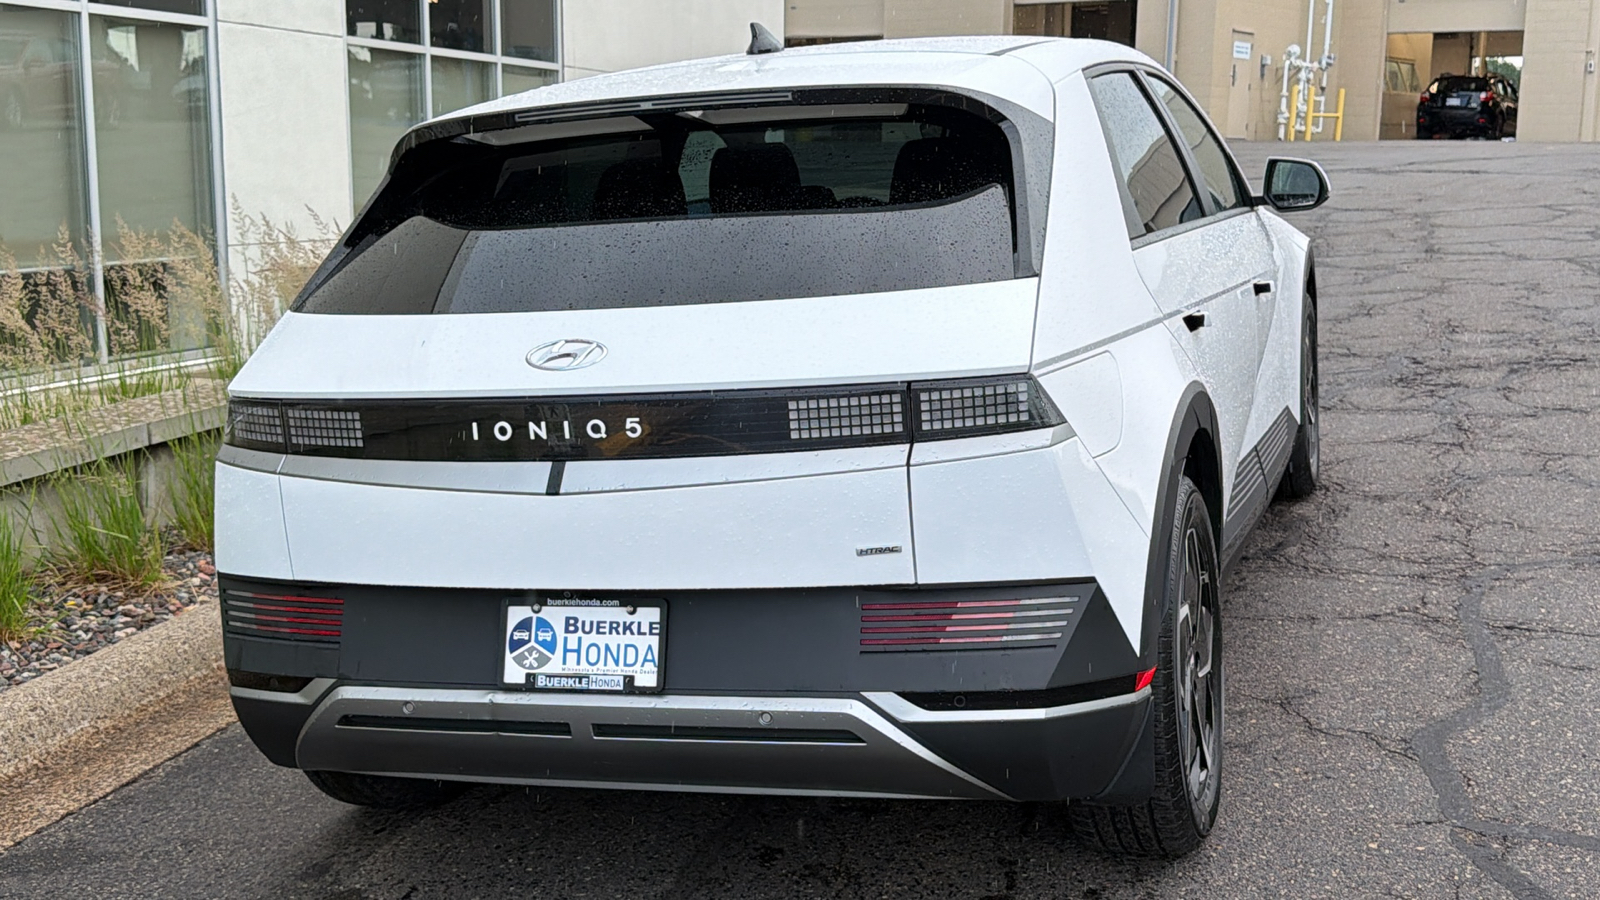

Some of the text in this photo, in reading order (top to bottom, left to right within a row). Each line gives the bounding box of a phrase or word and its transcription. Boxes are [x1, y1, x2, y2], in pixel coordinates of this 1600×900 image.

[471, 417, 643, 442] IONIQ 5
[859, 546, 899, 555] HTRAC
[547, 598, 620, 607] buerklehonda.com
[564, 616, 660, 636] BUERKLE
[562, 636, 658, 668] HONDA
[537, 675, 621, 688] BUERKLE HONDA
